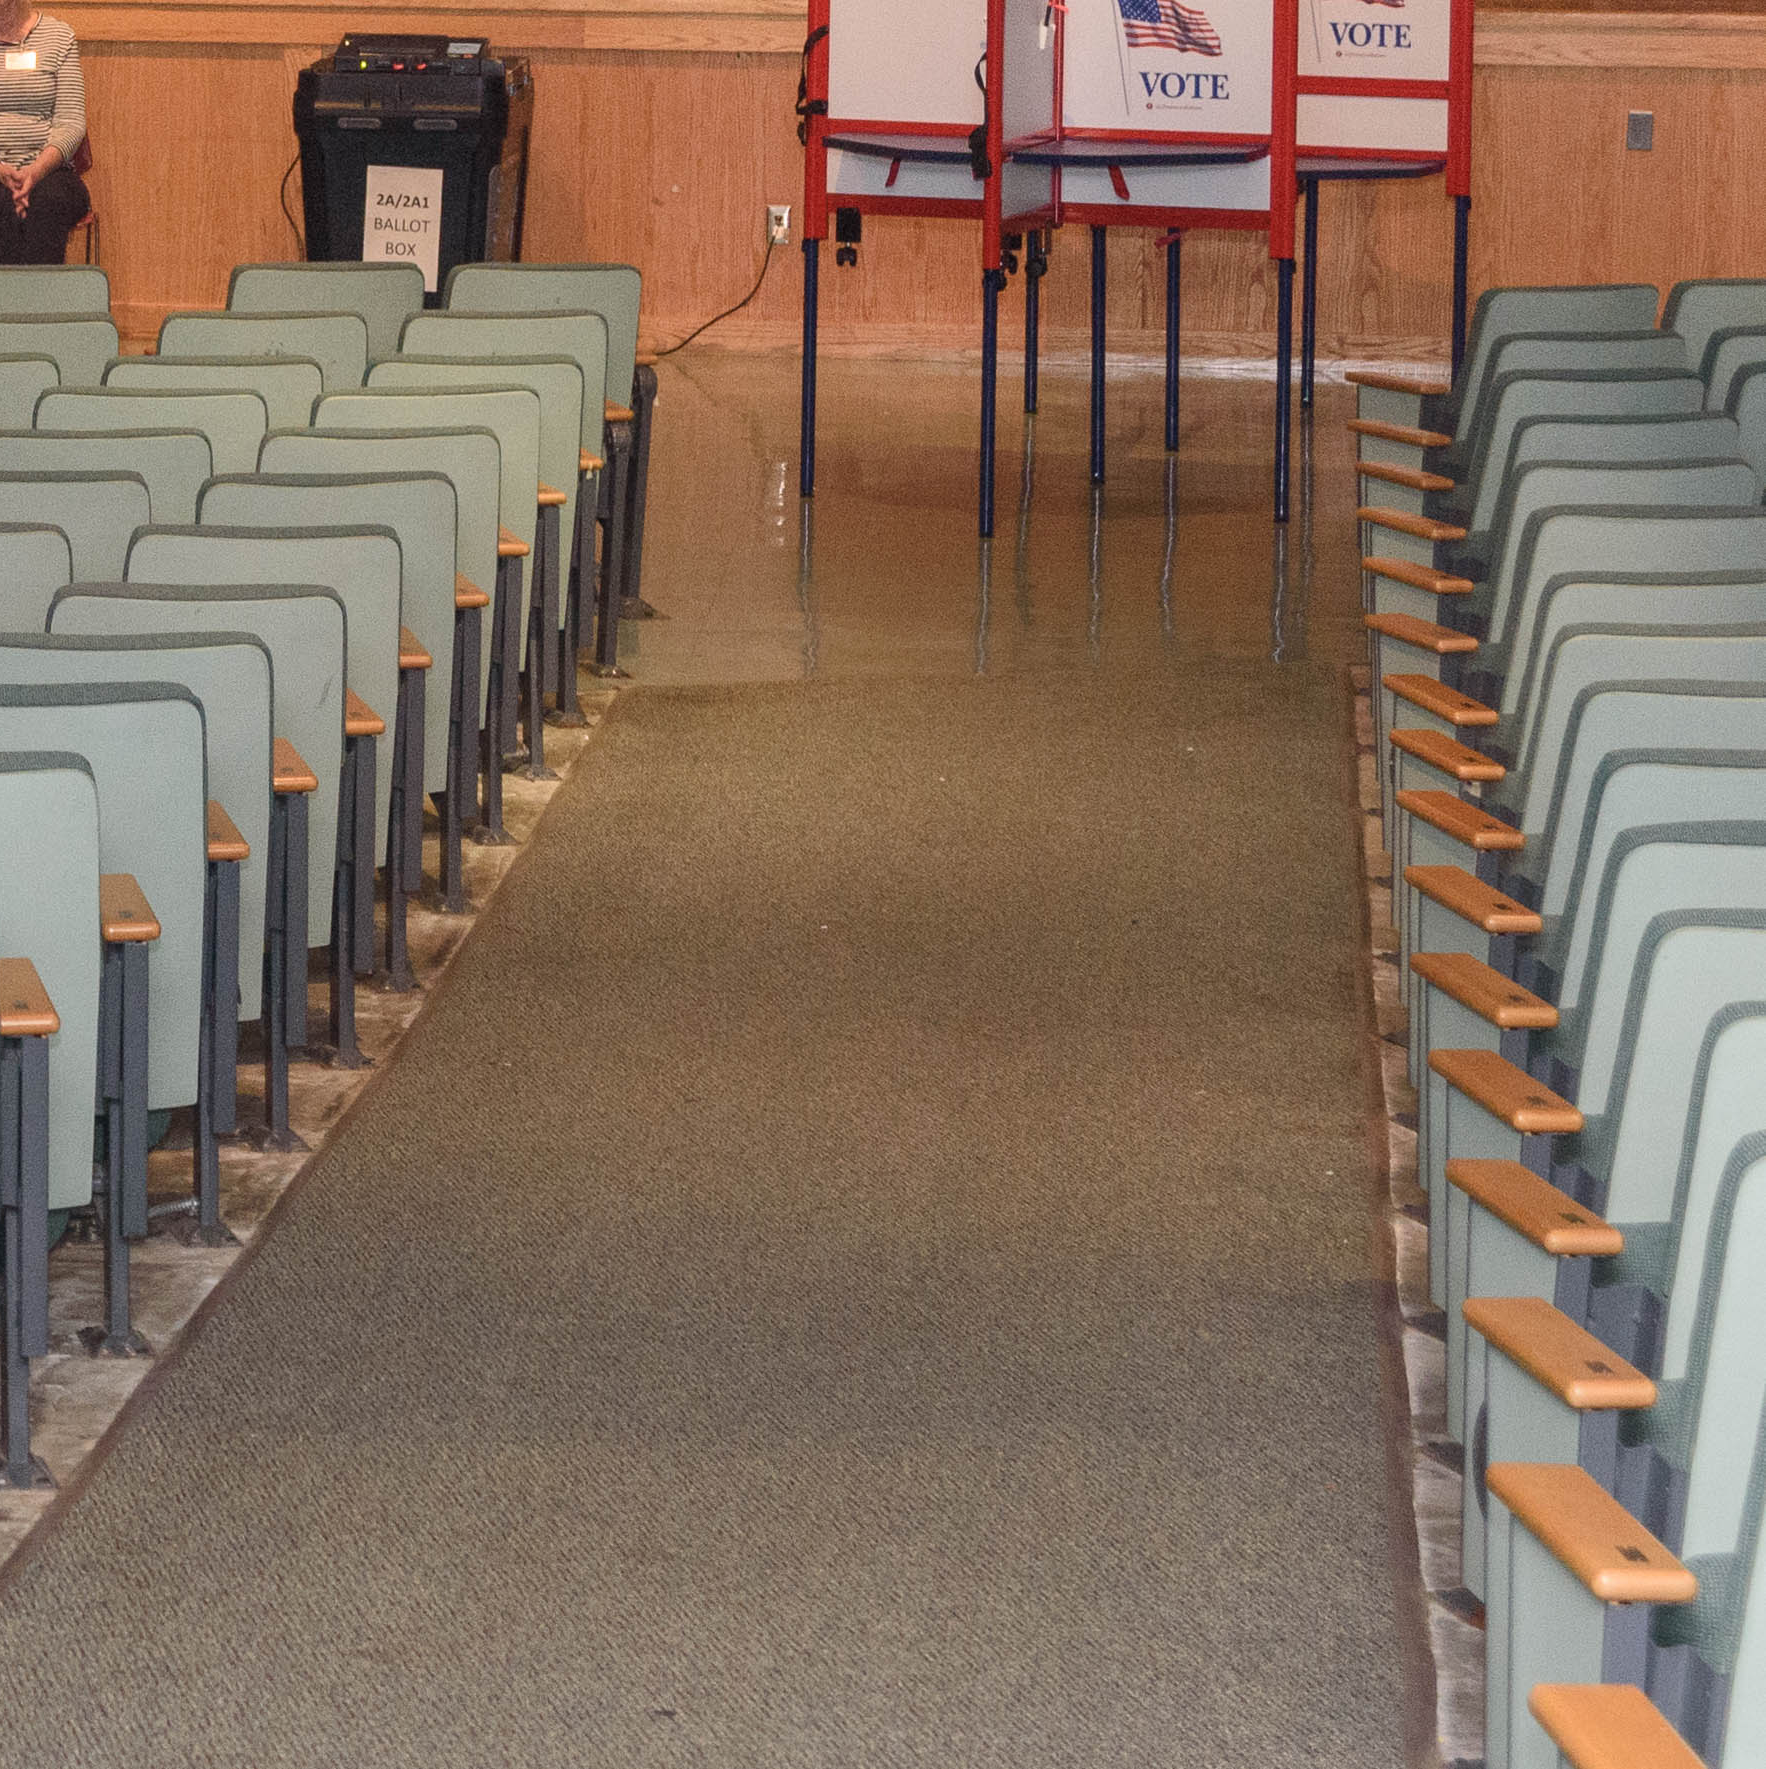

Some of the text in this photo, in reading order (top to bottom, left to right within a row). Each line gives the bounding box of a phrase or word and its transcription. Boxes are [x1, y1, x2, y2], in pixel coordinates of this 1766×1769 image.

[1329, 22, 1412, 48] VOTE
[1139, 71, 1230, 100] VOTE
[376, 193, 430, 209] 2A/2A1
[374, 217, 431, 233] BALLOT
[385, 241, 416, 256] BOX
